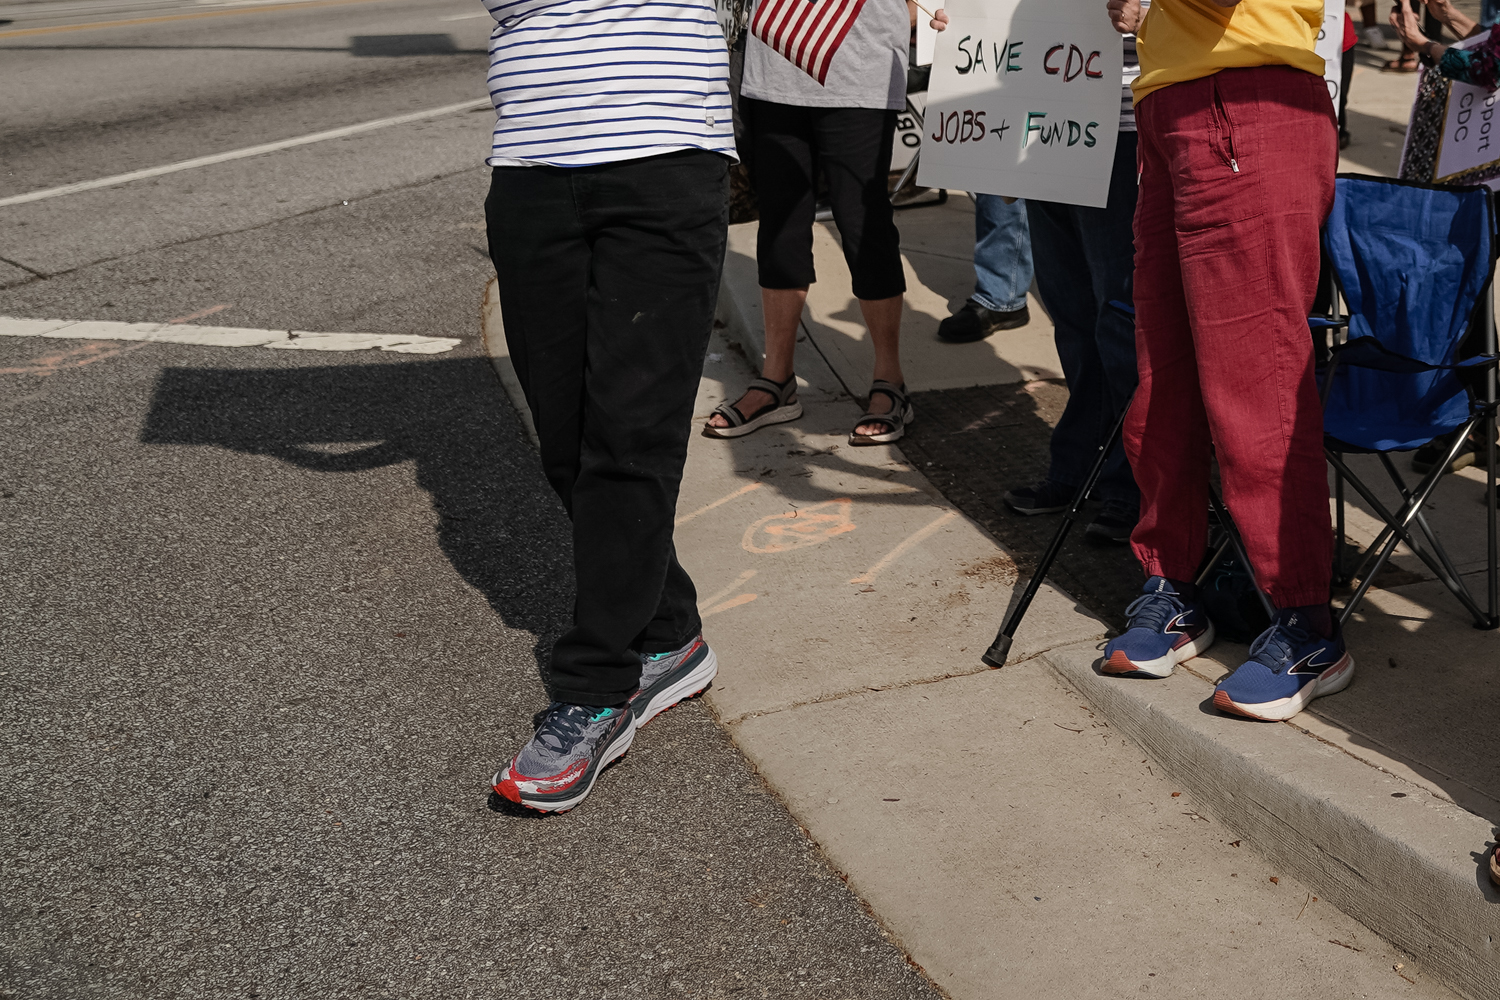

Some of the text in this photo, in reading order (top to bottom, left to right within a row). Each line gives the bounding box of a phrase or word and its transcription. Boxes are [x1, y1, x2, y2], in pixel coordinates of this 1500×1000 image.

[956, 35, 1103, 82] SAVE CDC
[932, 110, 986, 144] JOBS
[1454, 92, 1474, 142] CDC
[1478, 95, 1496, 153] pport
